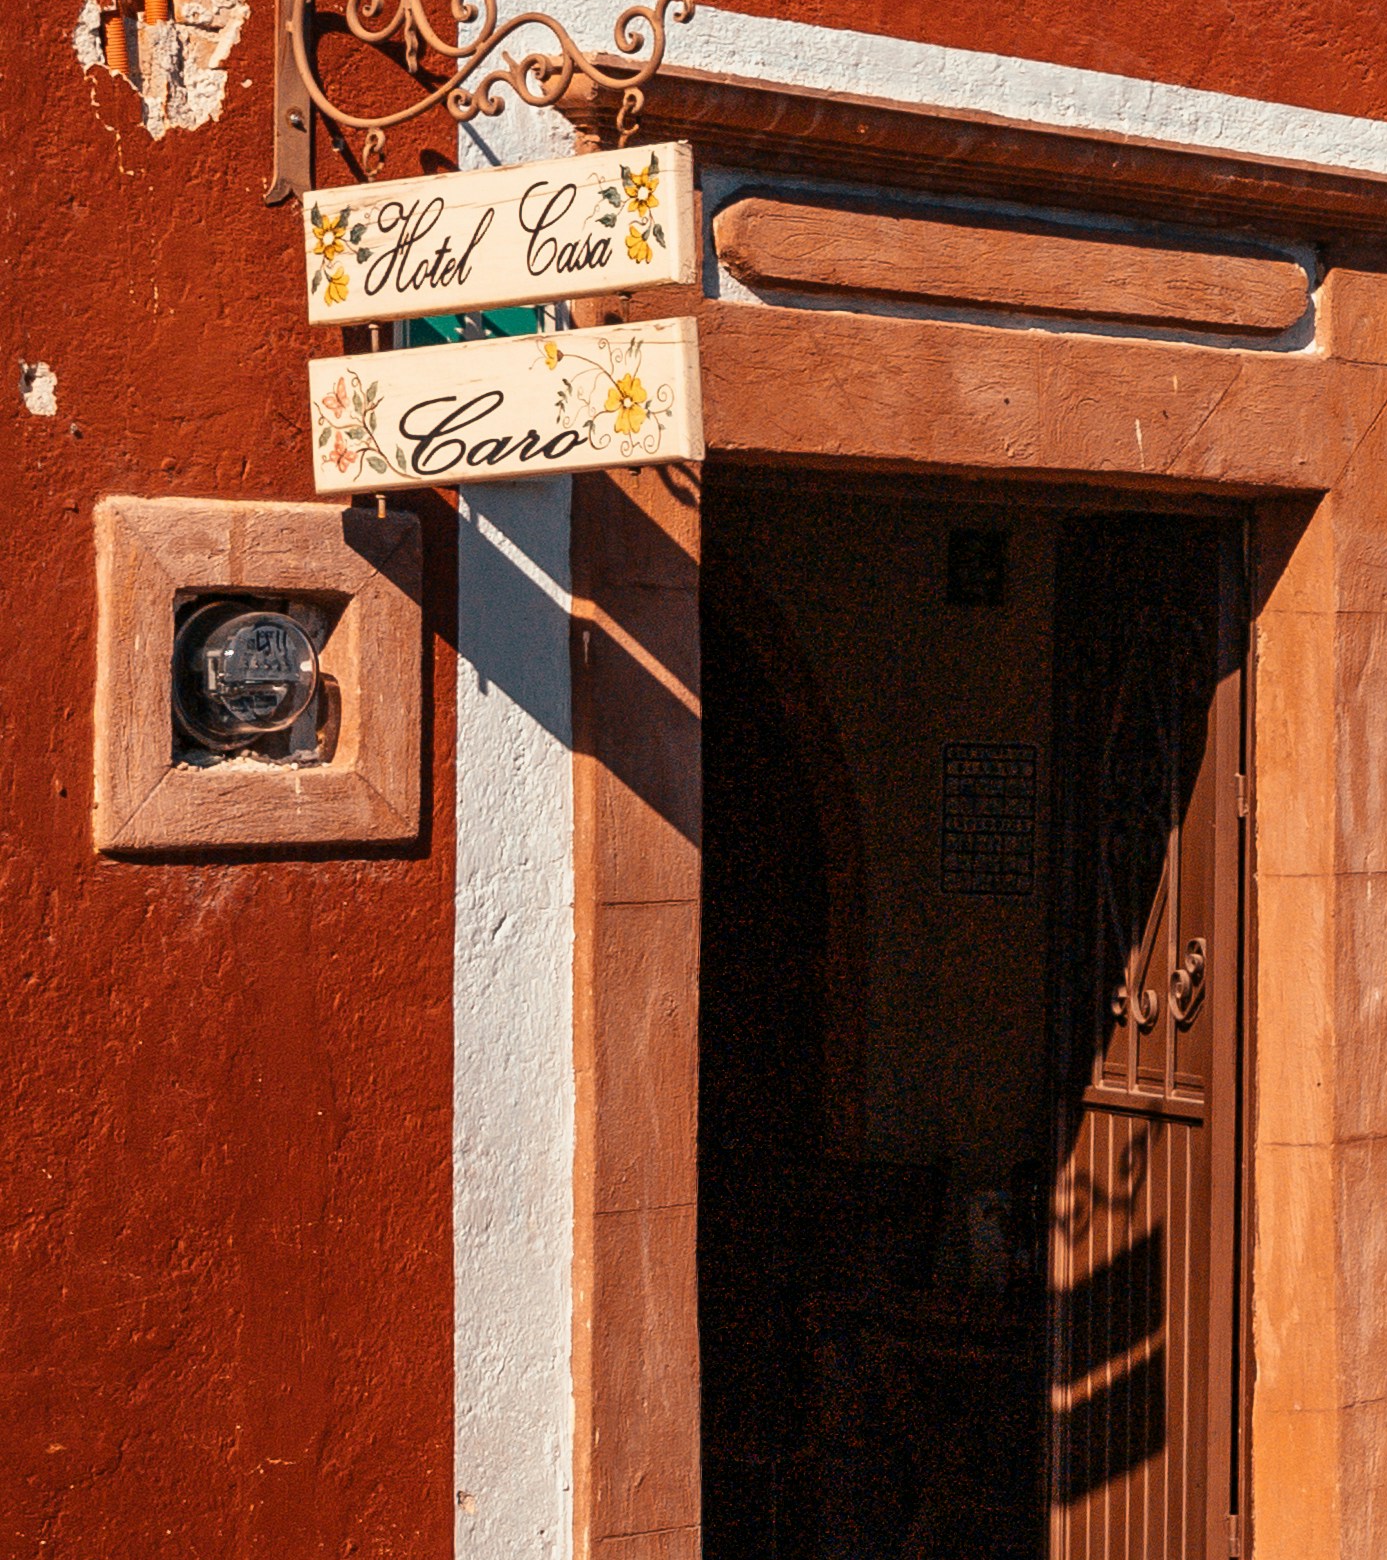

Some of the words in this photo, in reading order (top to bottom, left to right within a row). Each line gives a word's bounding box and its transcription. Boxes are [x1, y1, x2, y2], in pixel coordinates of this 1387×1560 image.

[364, 196, 496, 297] Hotel
[518, 181, 613, 277] Casa
[399, 390, 589, 476] Caro
